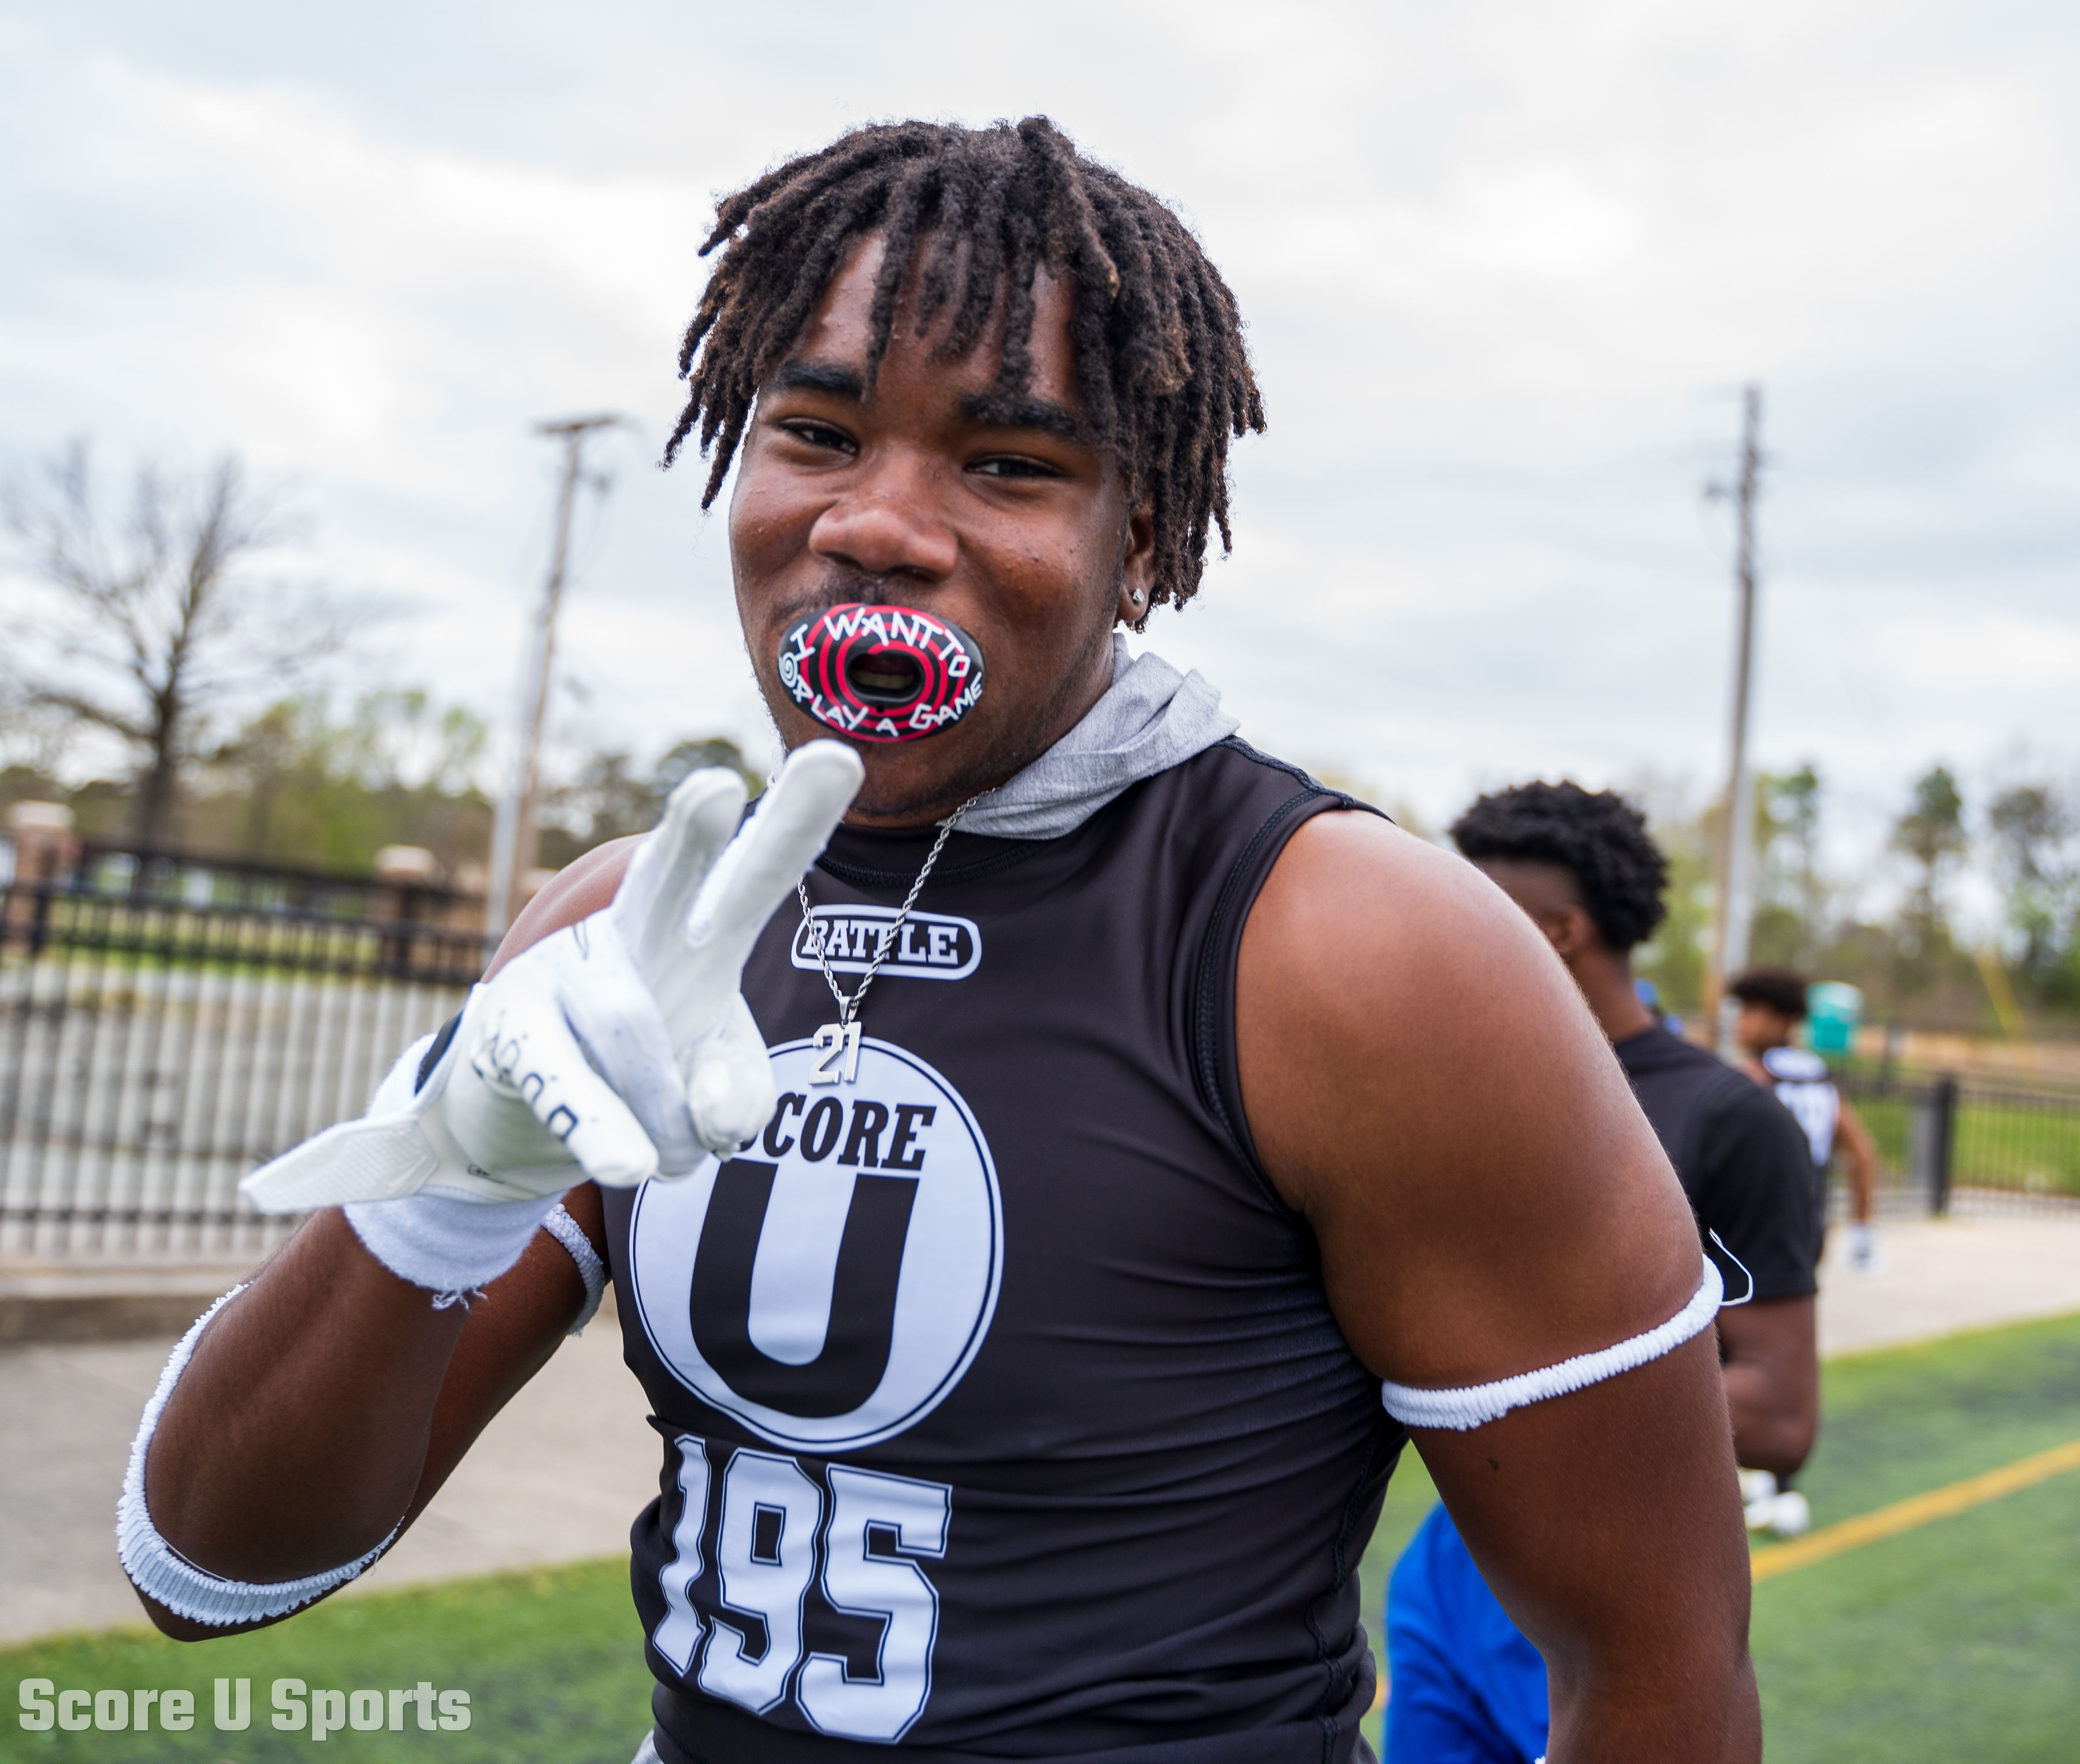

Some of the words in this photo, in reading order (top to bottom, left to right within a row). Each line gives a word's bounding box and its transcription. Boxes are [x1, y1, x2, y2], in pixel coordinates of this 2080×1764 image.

[790, 623, 815, 661] I
[824, 607, 944, 649] WANT
[938, 629, 971, 677] TO
[793, 674, 869, 730] PLAY
[876, 718, 900, 737] A
[909, 671, 983, 730] GAME
[801, 919, 959, 965] BATTLE
[809, 1020, 863, 1086] 21
[738, 1091, 937, 1171] CORE
[689, 1157, 920, 1419] U
[653, 1434, 953, 1744] 195
